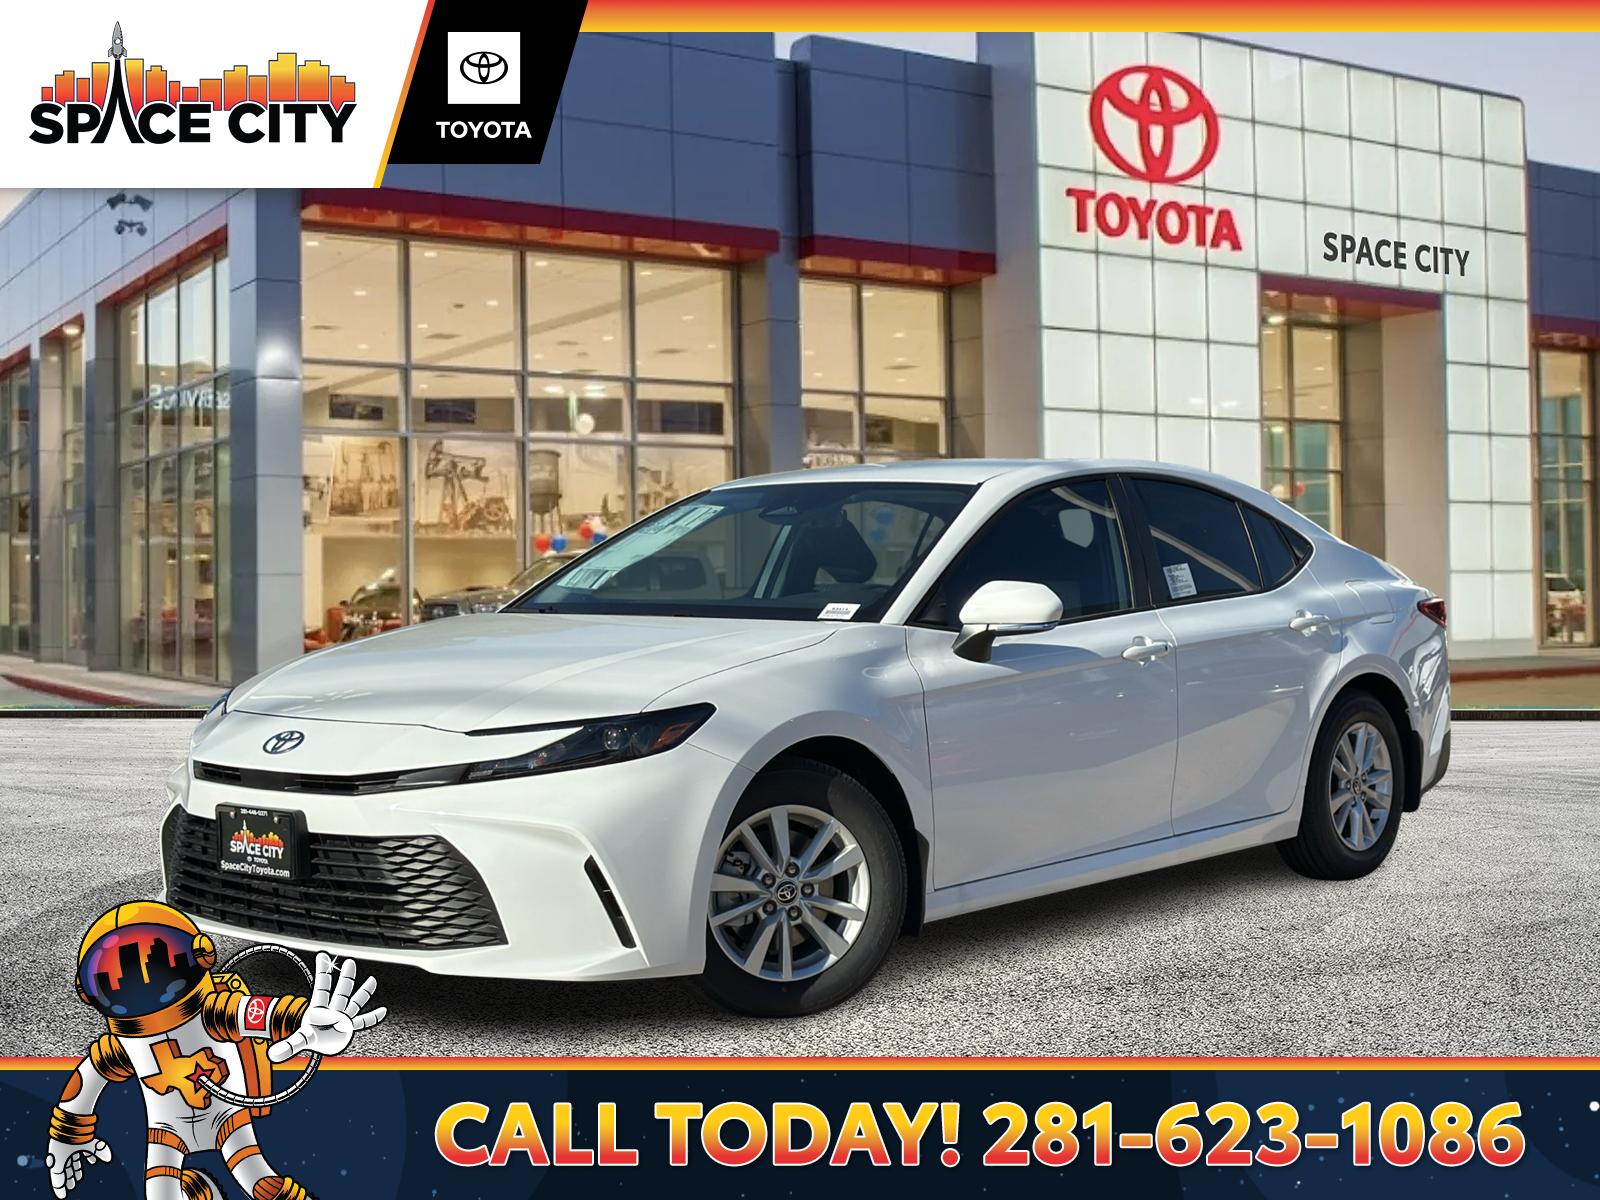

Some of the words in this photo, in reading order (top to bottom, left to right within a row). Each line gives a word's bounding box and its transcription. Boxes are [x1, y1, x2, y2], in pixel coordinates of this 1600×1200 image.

[1066, 187, 1243, 251] TOYOTA
[1323, 231, 1407, 270] SPACE
[1415, 243, 1471, 277] CITY
[230, 839, 261, 855] SPACE
[262, 845, 284, 859] CITY
[220, 859, 291, 878] SpaceCityToyota.com
